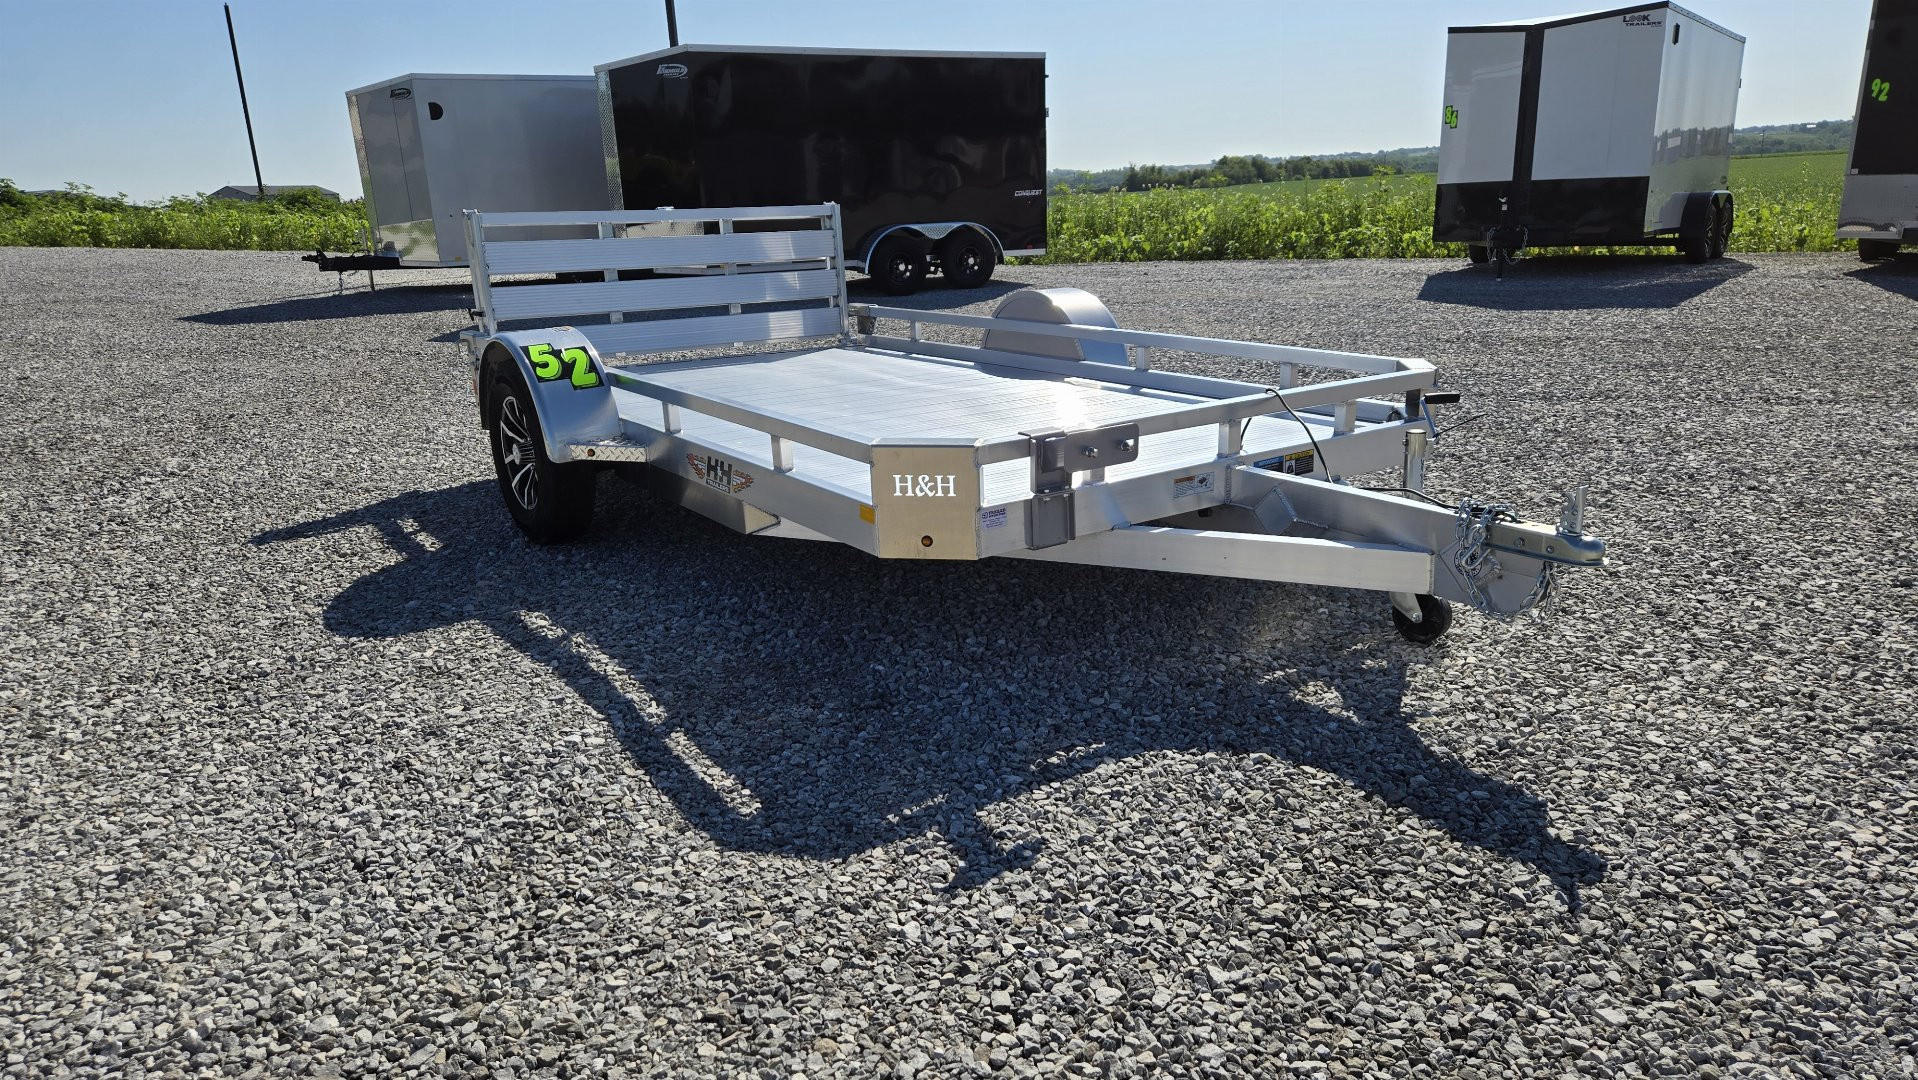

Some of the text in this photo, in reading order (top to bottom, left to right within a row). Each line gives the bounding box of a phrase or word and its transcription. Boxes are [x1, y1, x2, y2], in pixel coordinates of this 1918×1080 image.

[1623, 14, 1650, 22] LOOK
[1871, 78, 1889, 101] 92
[1445, 106, 1458, 128] 86
[528, 344, 600, 387] 52
[892, 474, 957, 497] H&H
